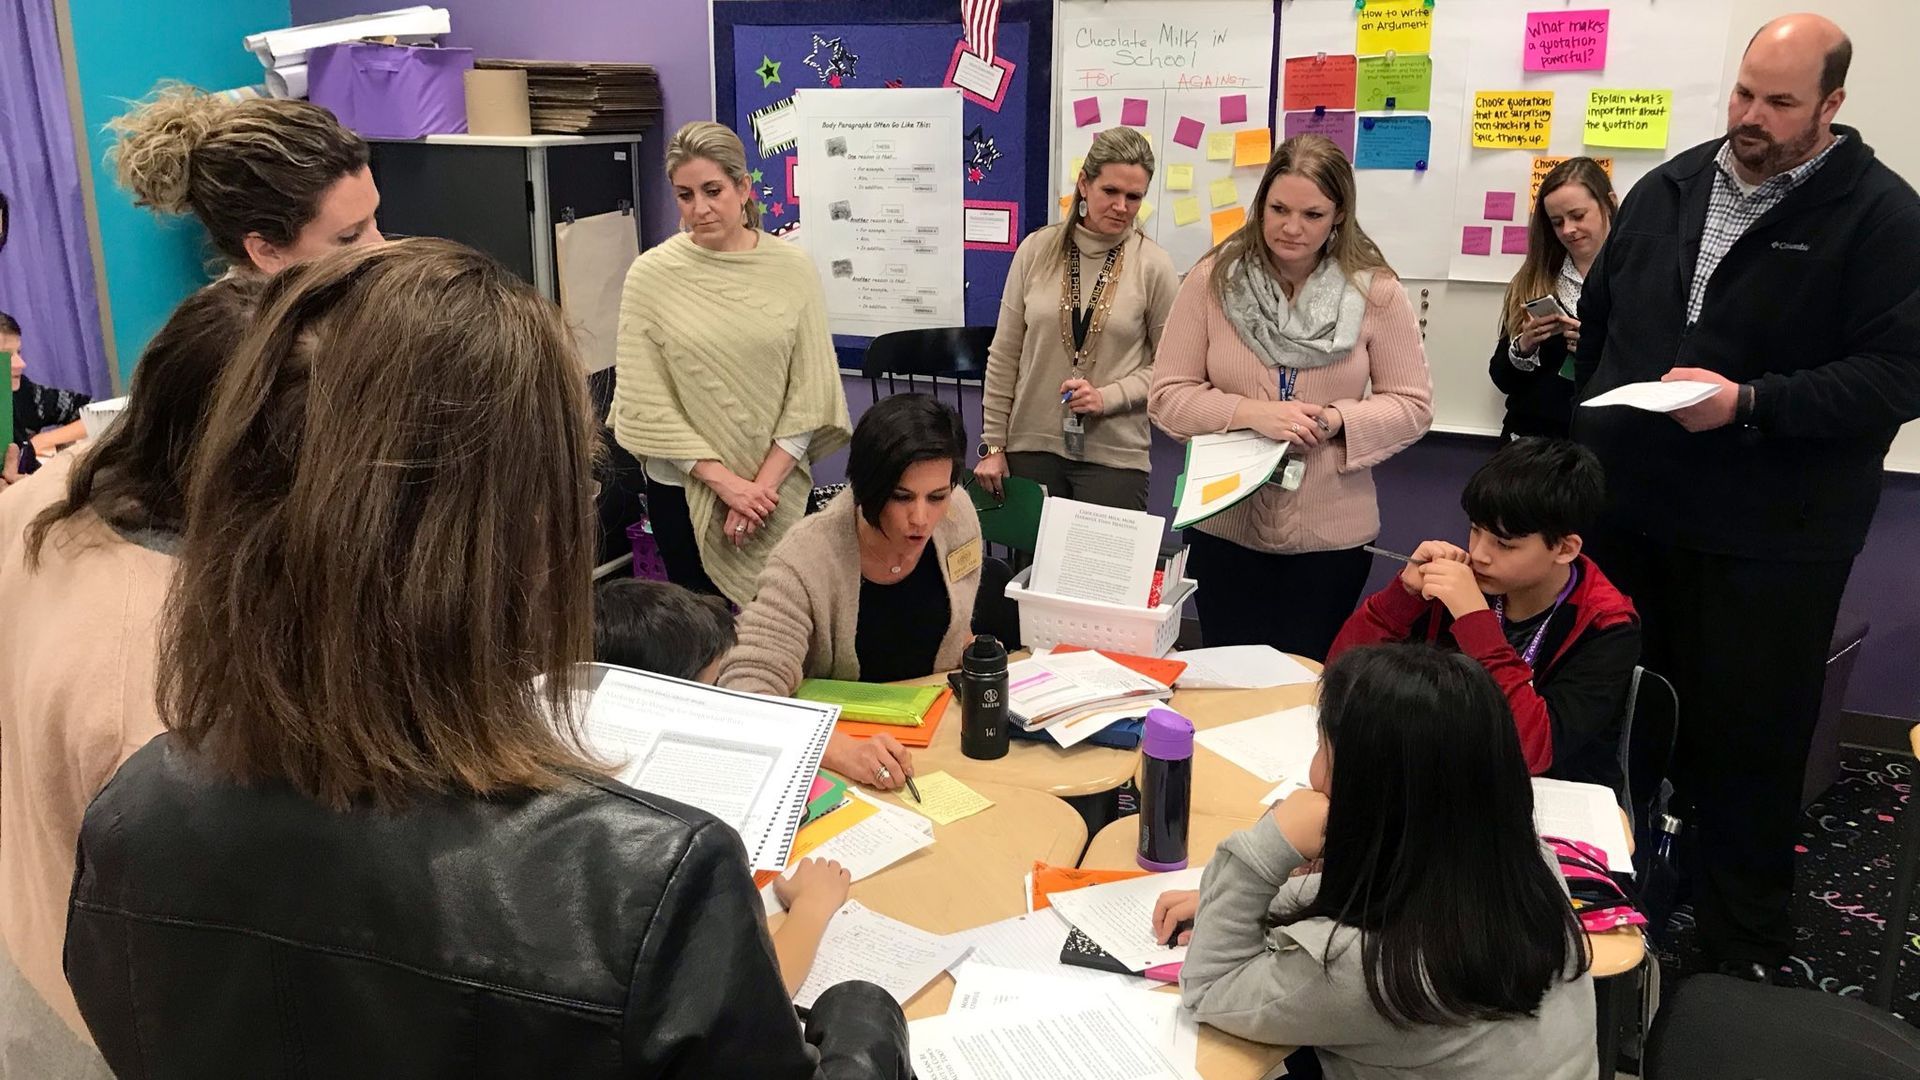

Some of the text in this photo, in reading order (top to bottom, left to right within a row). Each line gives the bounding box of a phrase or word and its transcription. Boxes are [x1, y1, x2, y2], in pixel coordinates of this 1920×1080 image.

[1362, 10, 1382, 18] How
[1401, 8, 1429, 17] write
[1377, 21, 1428, 31] Argument
[1528, 19, 1605, 38] What makes
[1076, 28, 1147, 48] Chocolate
[1160, 23, 1198, 49] Milk
[1528, 36, 1596, 55] a quotation
[1112, 48, 1196, 68] School
[1541, 49, 1594, 68] powerful?
[1178, 74, 1251, 92] AGAINST
[1476, 97, 1552, 110] Choose quotations
[1591, 92, 1663, 105] Explain what's
[1474, 109, 1551, 121] that are surprising
[1588, 105, 1667, 118] important about
[822, 121, 836, 130] Body
[838, 121, 871, 130] Paragraphs
[1475, 120, 1543, 132] even shocking to
[1586, 120, 1648, 132] the quotation
[1496, 133, 1527, 146] things
[1529, 135, 1544, 144] up.
[1071, 248, 1080, 308] THER PRIDE
[1089, 281, 1105, 309] PRIDE
